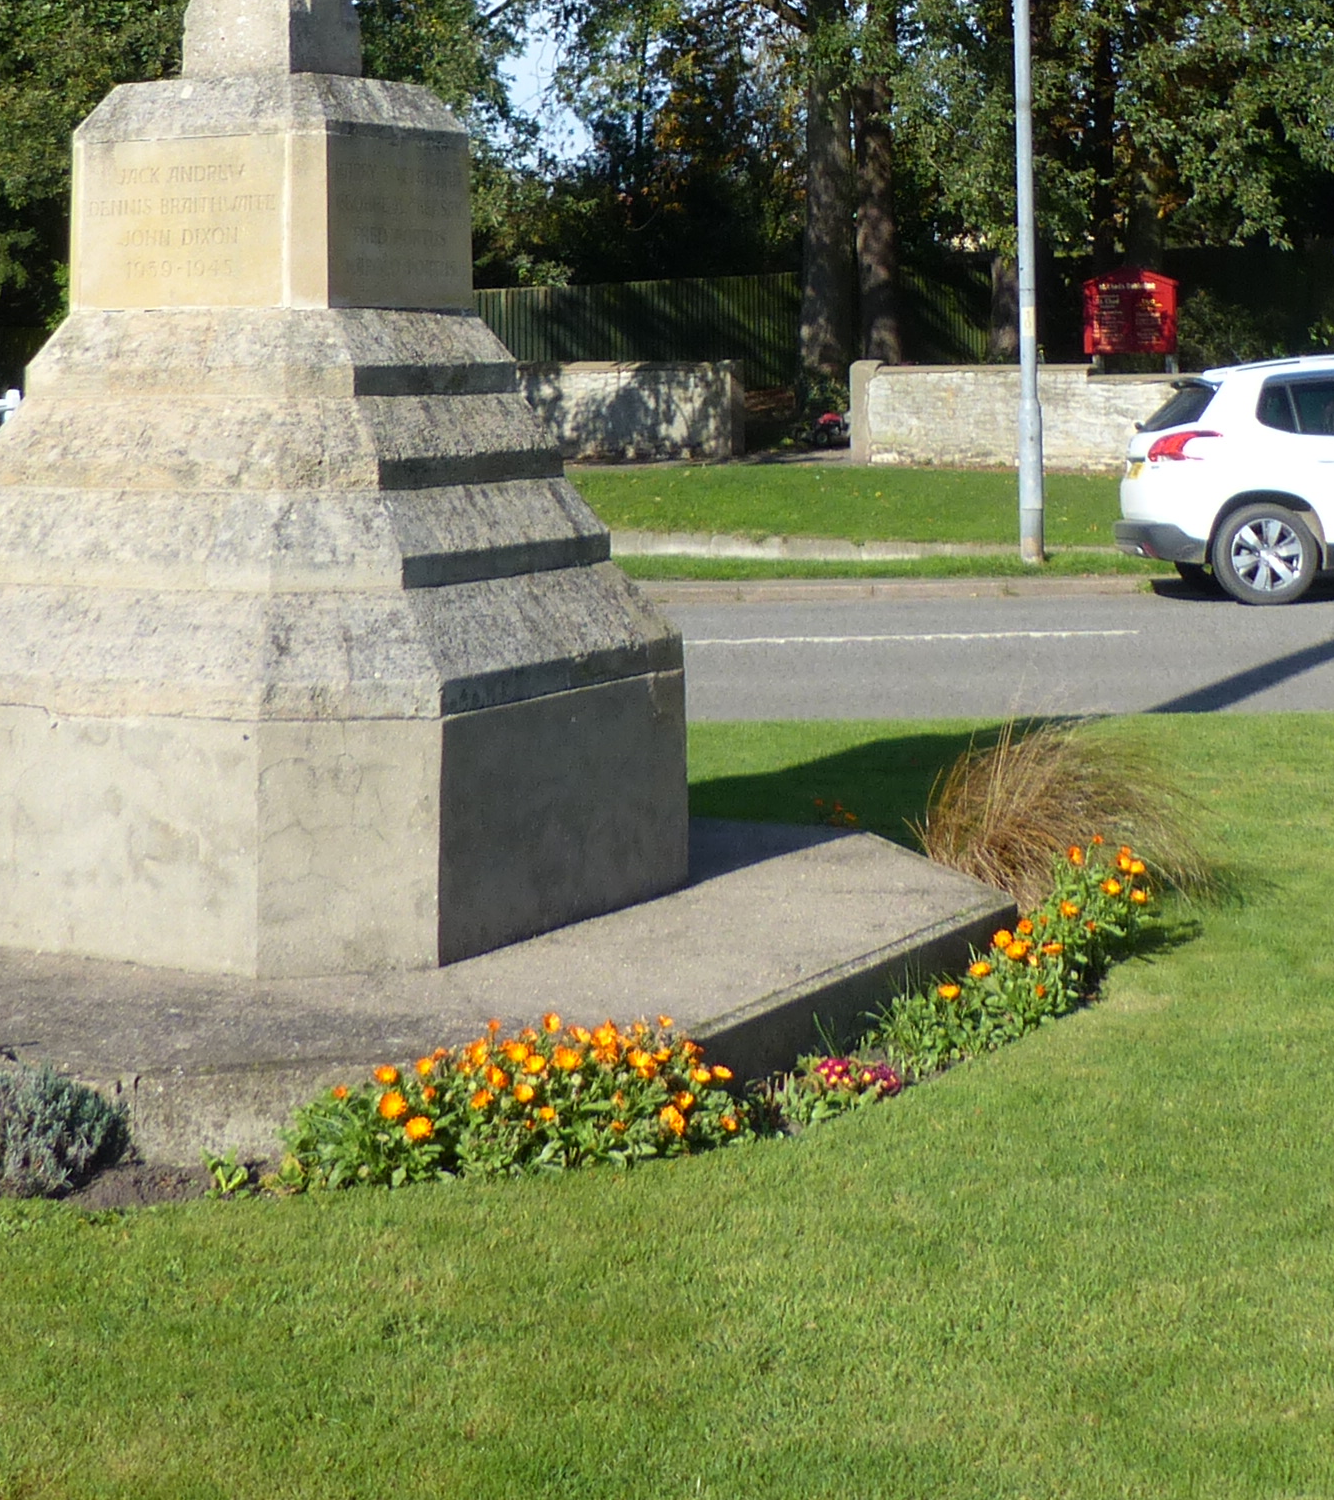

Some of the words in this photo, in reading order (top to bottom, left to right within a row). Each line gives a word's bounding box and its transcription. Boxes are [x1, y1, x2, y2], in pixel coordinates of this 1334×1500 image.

[116, 166, 160, 185] JACK
[166, 163, 246, 183] ANDREW
[88, 197, 152, 217] DENNIS
[160, 194, 277, 215] BRAITHWAITE
[116, 229, 171, 248] JOHN
[181, 226, 239, 247] DIXON
